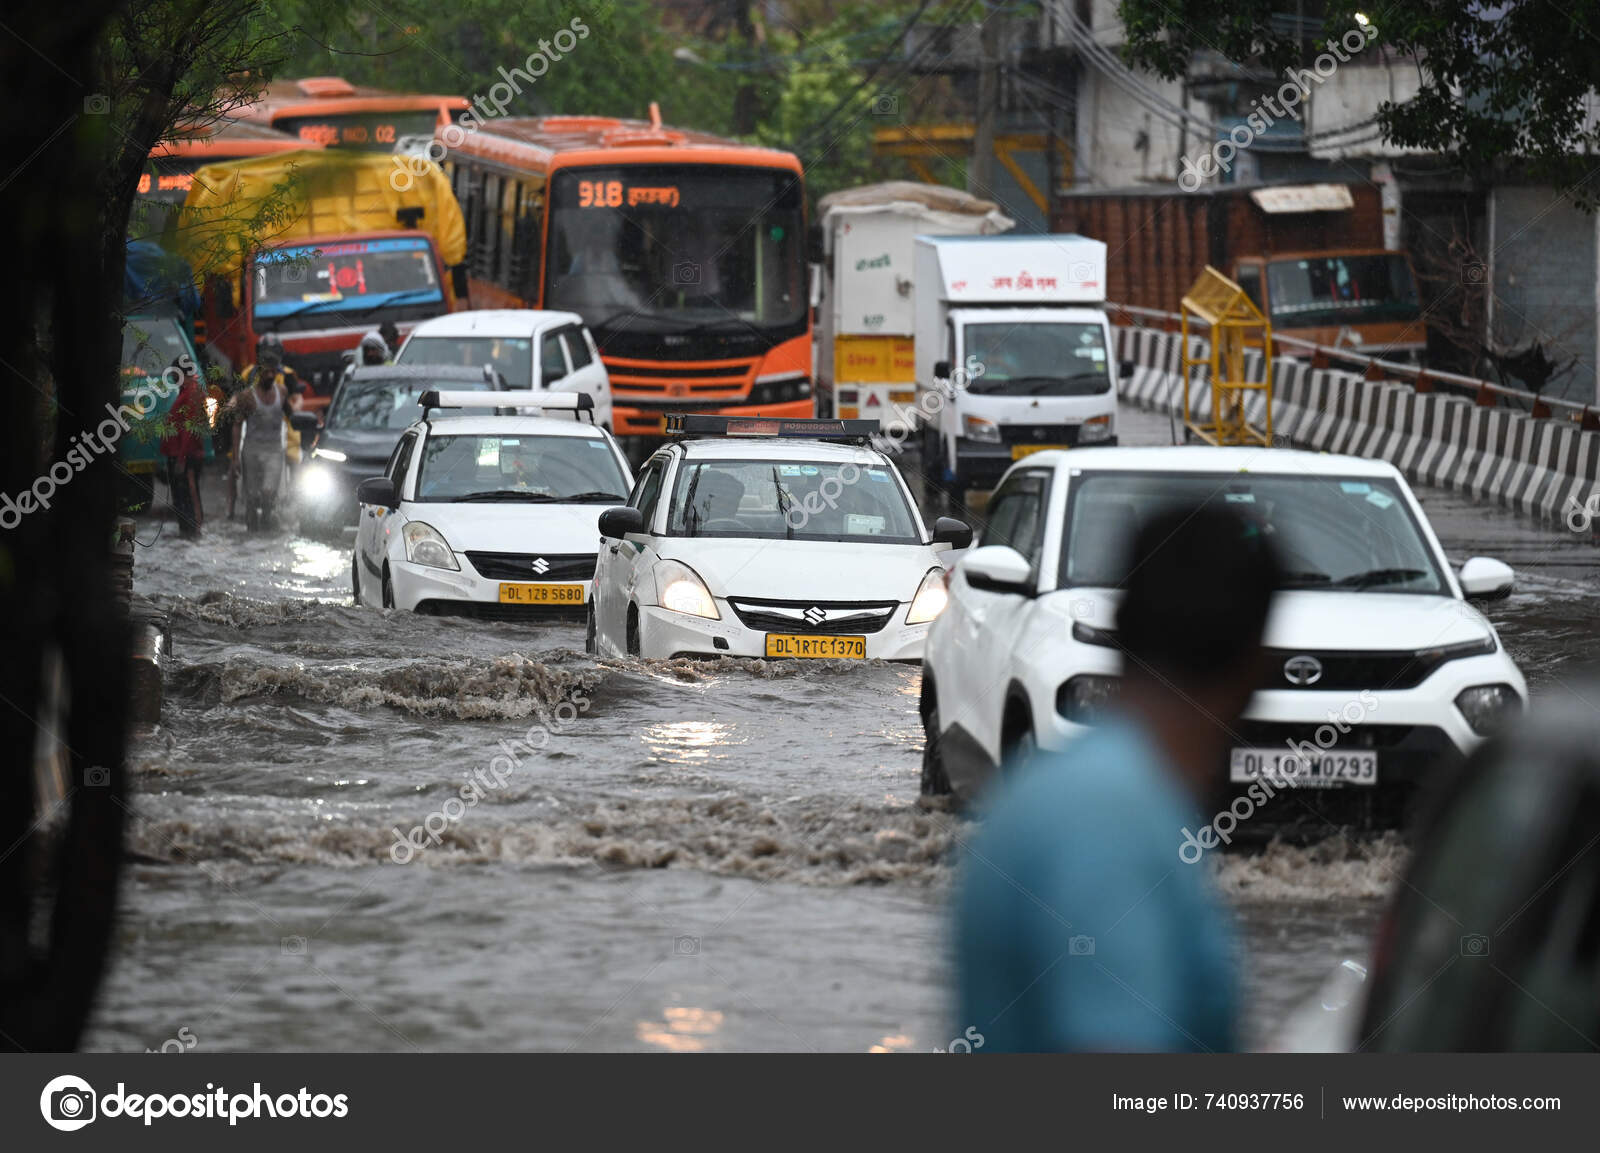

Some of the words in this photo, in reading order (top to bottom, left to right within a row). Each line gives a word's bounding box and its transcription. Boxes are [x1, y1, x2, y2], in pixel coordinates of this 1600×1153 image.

[578, 181, 623, 207] 918
[508, 587, 522, 600] DL
[552, 588, 581, 601] 5680
